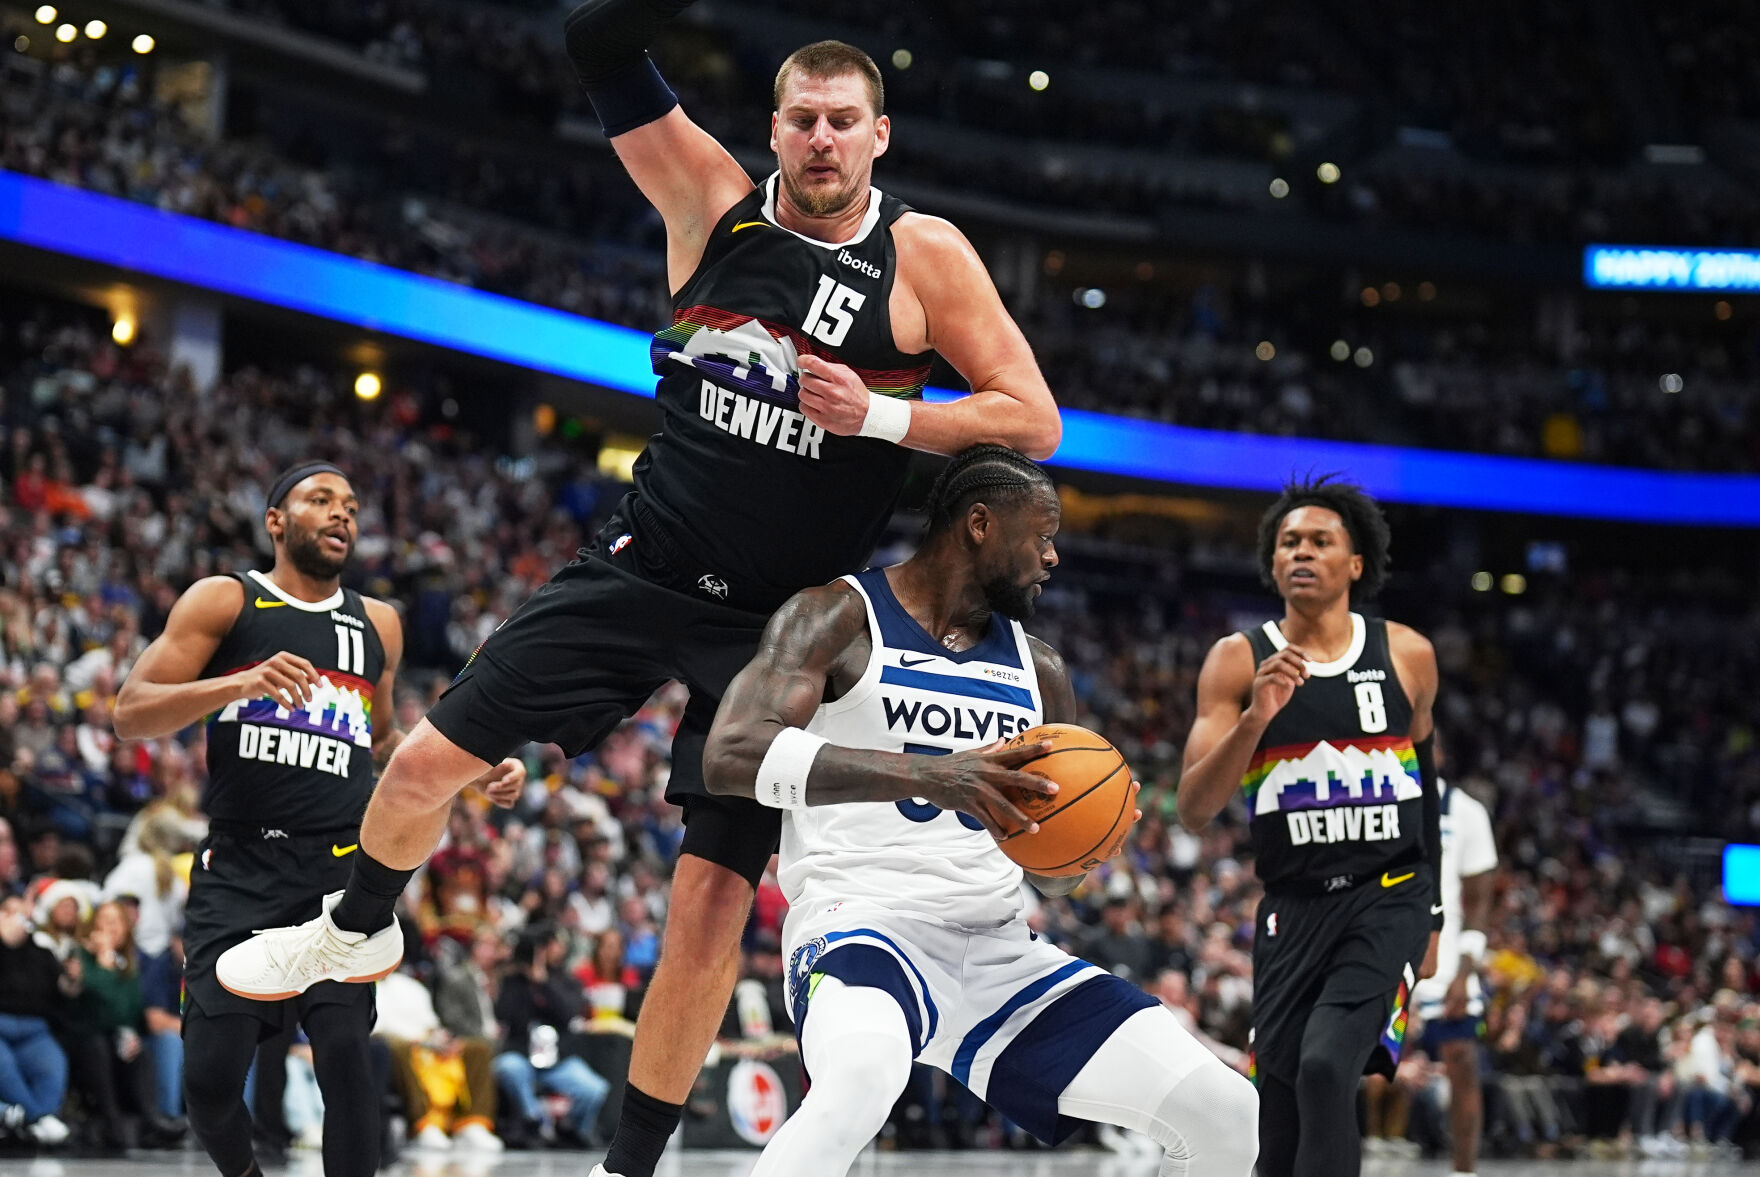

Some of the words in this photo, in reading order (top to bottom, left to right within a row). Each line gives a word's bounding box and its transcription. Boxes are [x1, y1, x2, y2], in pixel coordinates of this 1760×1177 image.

[837, 248, 882, 279] ibotta
[801, 273, 866, 347] 15
[700, 379, 825, 460] DENVER
[335, 624, 365, 676] 11
[990, 669, 1020, 682] sezzle
[1354, 681, 1388, 734] 8
[239, 723, 352, 779] DENVER
[1286, 804, 1401, 846] DENVER
